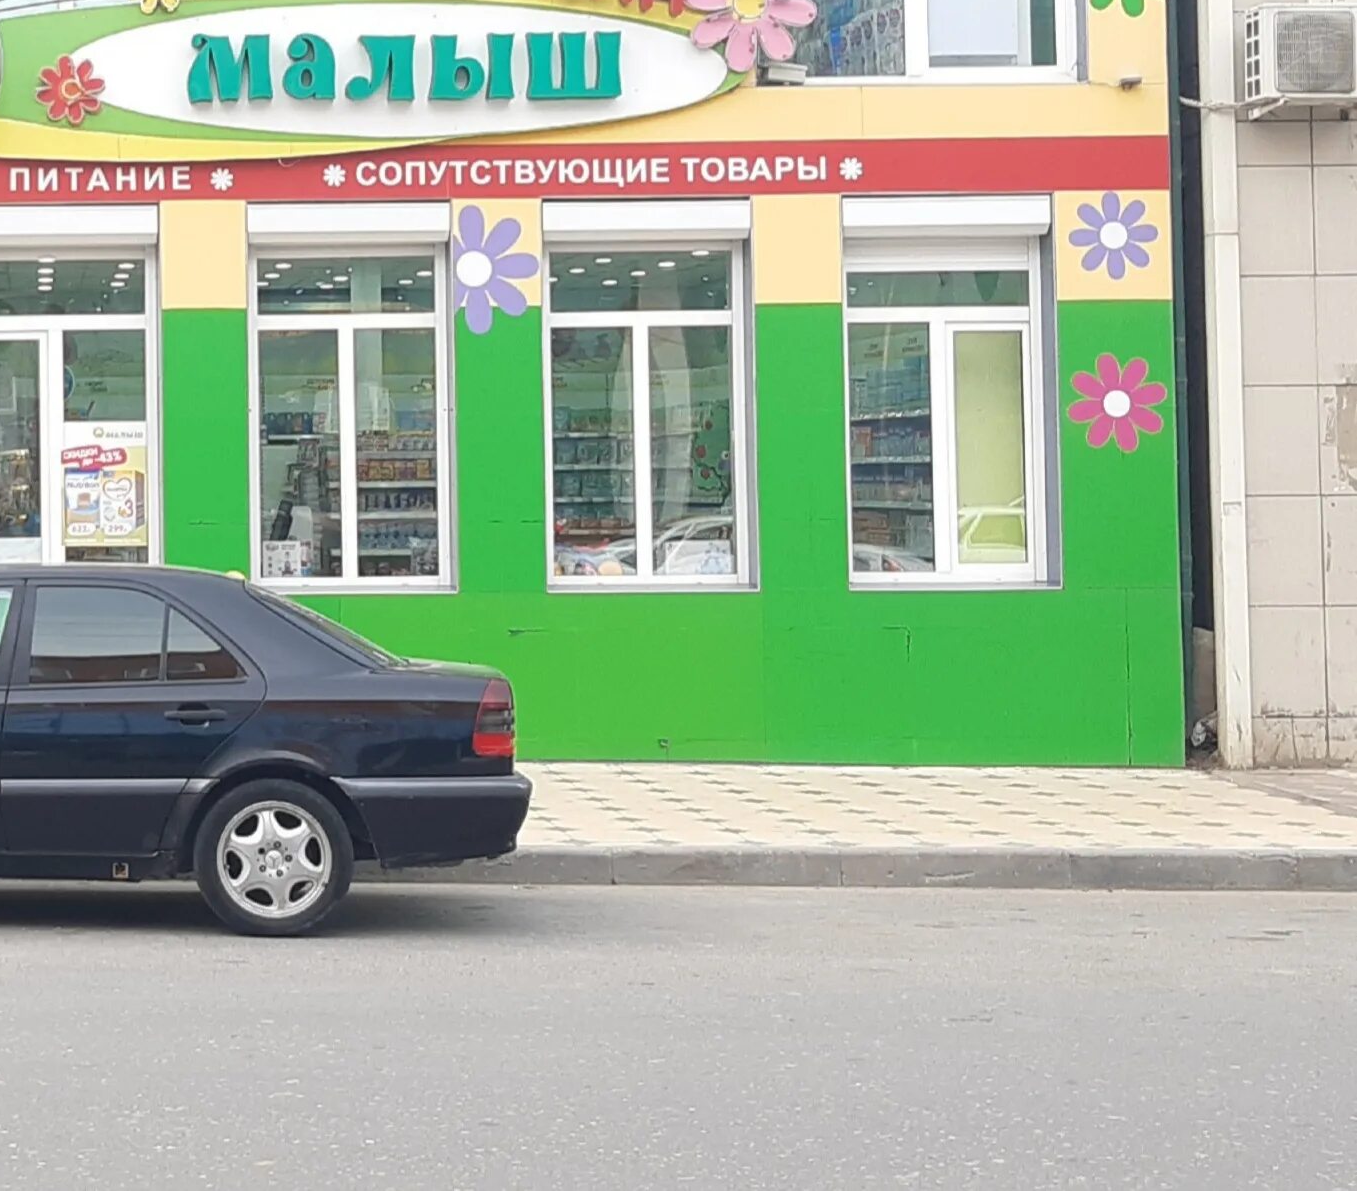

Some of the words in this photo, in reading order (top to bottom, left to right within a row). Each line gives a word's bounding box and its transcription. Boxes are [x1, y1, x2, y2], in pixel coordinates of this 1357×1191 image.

[9, 165, 193, 192] ПИТАНИЕ
[355, 157, 670, 187] СОПУТСТВУЮЩИЕ
[680, 155, 828, 183] ТОВАРЫ
